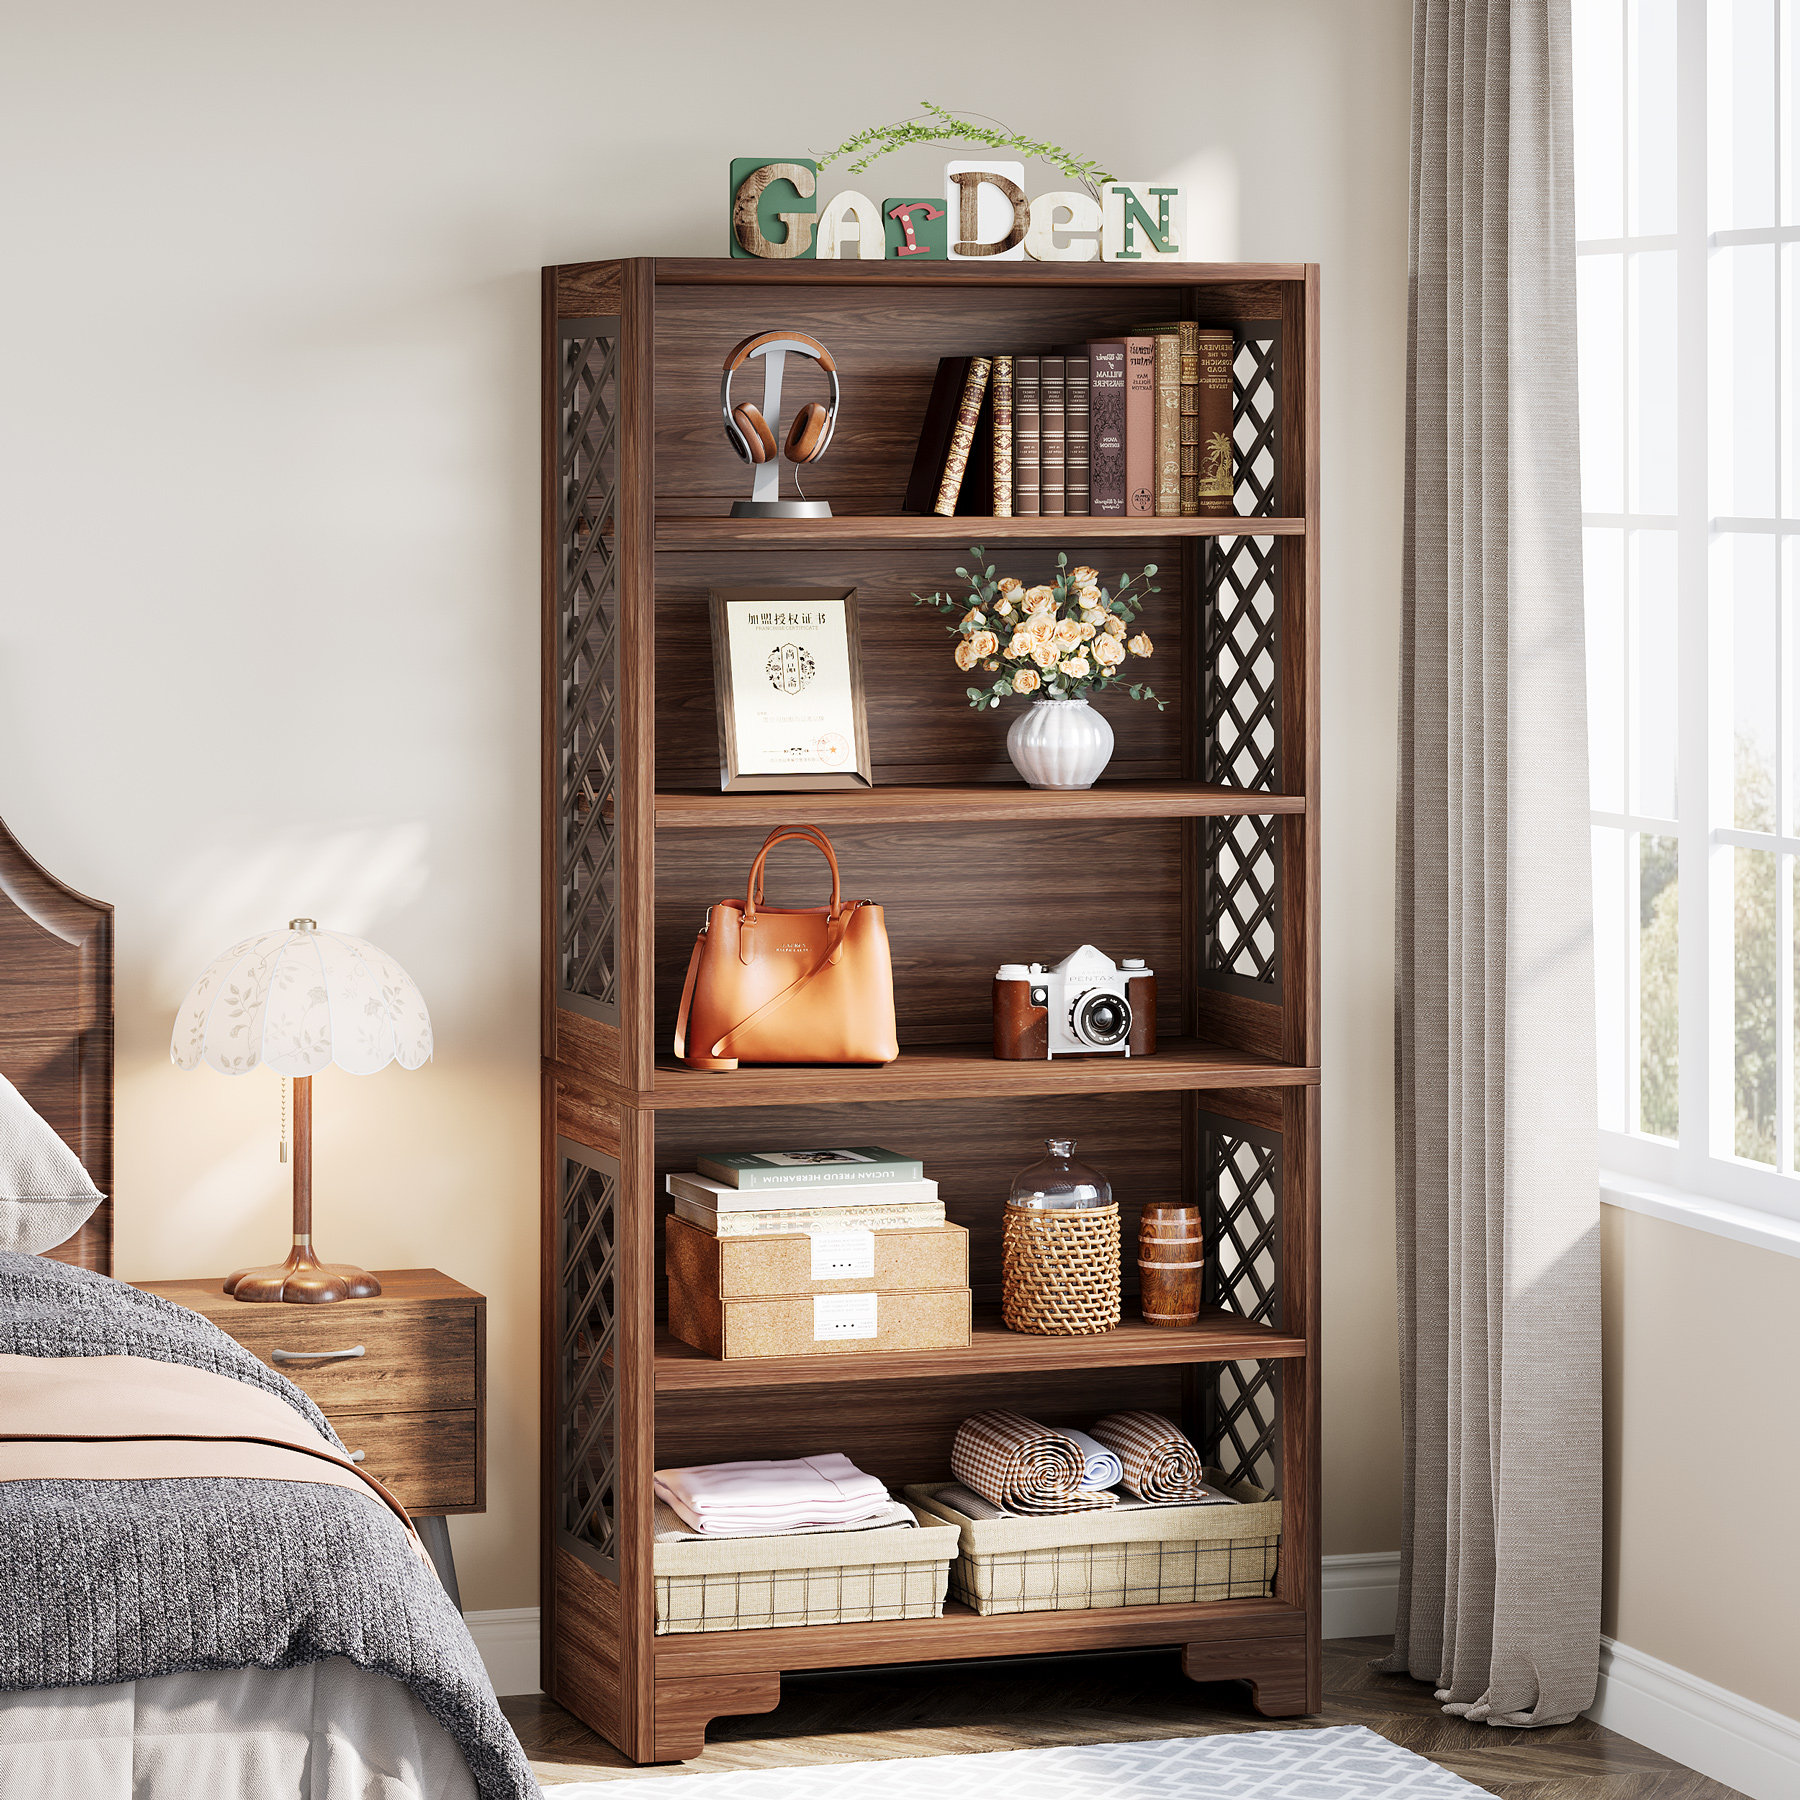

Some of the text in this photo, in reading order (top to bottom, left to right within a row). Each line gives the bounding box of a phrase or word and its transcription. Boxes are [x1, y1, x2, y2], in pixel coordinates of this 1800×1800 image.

[763, 1173, 821, 1183] HERBARIUM
[823, 1172, 855, 1181] FREUD
[856, 1170, 895, 1180] LUCIAN
